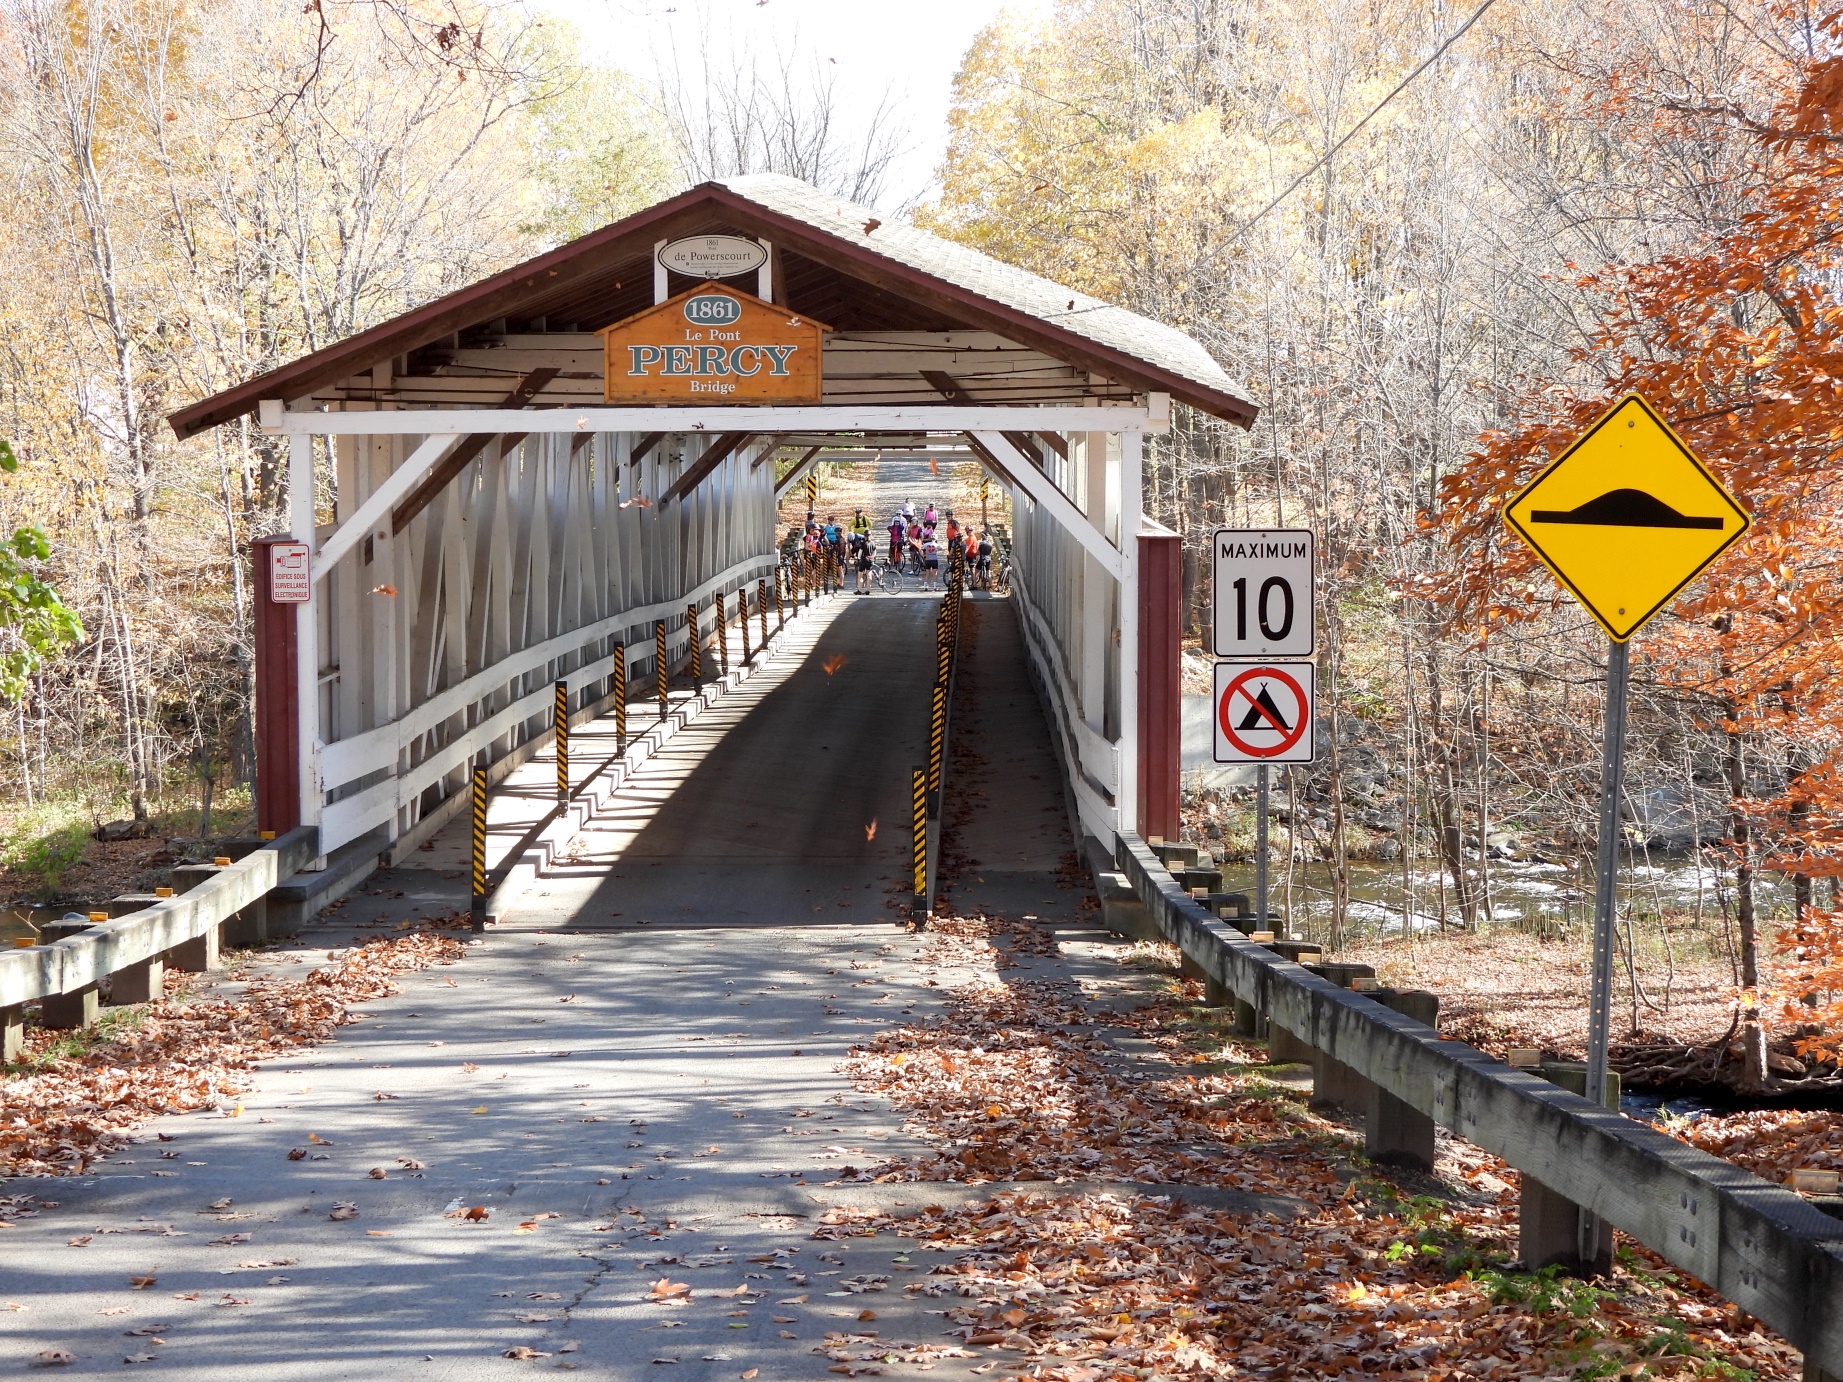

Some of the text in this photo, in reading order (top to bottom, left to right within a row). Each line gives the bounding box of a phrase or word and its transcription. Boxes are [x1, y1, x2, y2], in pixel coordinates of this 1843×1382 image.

[674, 251, 751, 261] de Powerscourt
[689, 301, 735, 318] 1861
[685, 329, 741, 341] Le Pont
[628, 345, 797, 376] PERCY
[690, 380, 736, 394] Bridge
[1221, 543, 1306, 558] MAXIMUM
[1233, 576, 1294, 641] 10
